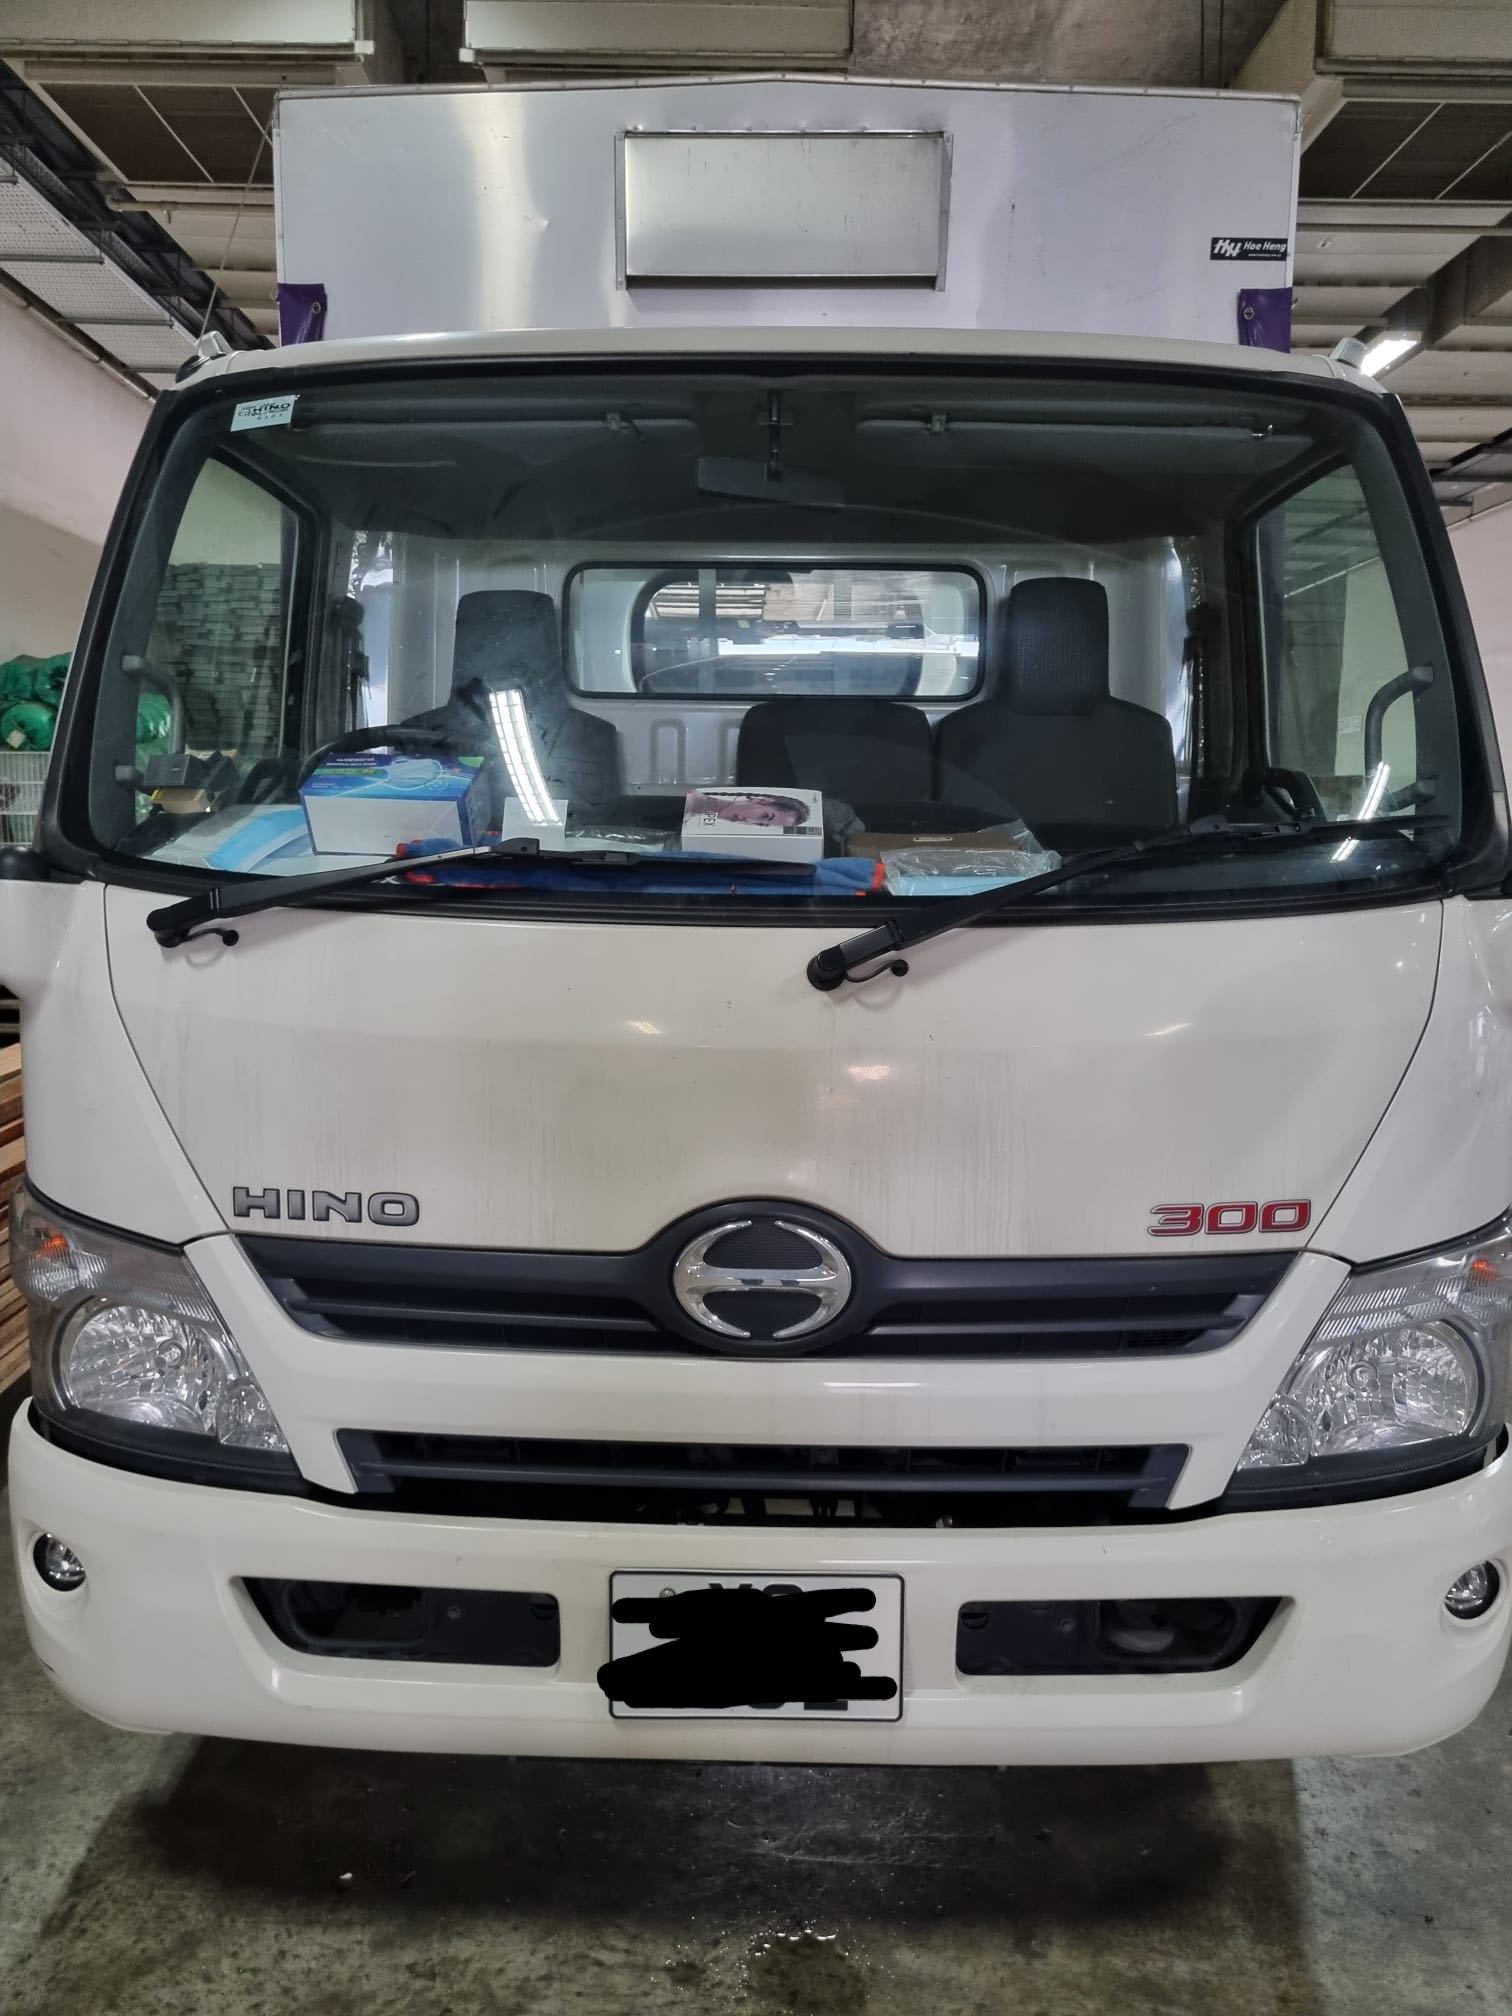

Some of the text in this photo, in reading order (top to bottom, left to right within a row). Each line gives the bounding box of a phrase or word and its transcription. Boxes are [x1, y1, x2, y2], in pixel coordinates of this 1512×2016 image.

[1243, 241, 1287, 253] Hoe Heng
[233, 1187, 420, 1226] HINO
[1147, 1199, 1312, 1237] 300
